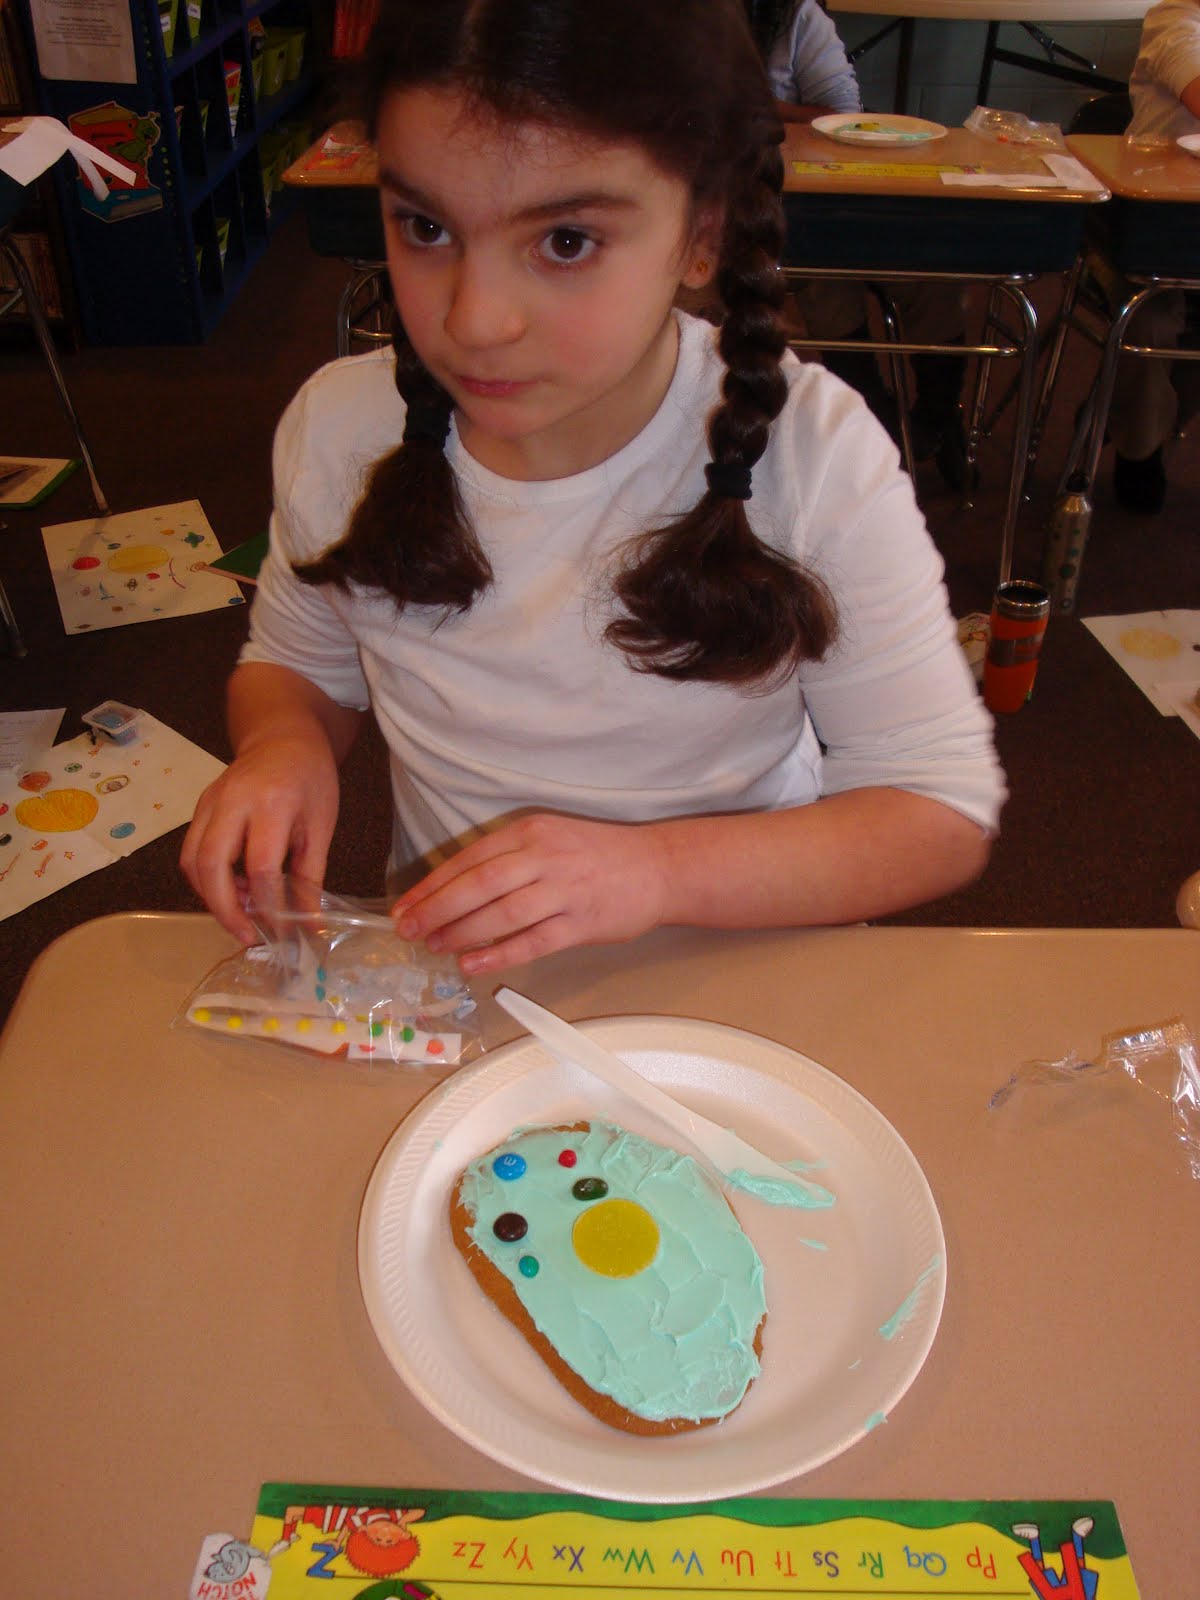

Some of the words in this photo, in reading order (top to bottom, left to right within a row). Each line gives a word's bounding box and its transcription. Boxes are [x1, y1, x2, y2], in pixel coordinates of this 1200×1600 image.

[306, 1543, 343, 1578] Z
[452, 1541, 487, 1569] Zz
[502, 1536, 534, 1570] Yy
[552, 1545, 586, 1573] Xx
[602, 1547, 655, 1573] Ww
[671, 1548, 705, 1576] Vv
[720, 1549, 754, 1577] Uu
[775, 1551, 798, 1578] Tt
[811, 1550, 841, 1579] Ss
[858, 1551, 885, 1579] Rr
[902, 1544, 947, 1578] Qq
[966, 1546, 998, 1581] Pp
[197, 1571, 257, 1600] NOTCH
